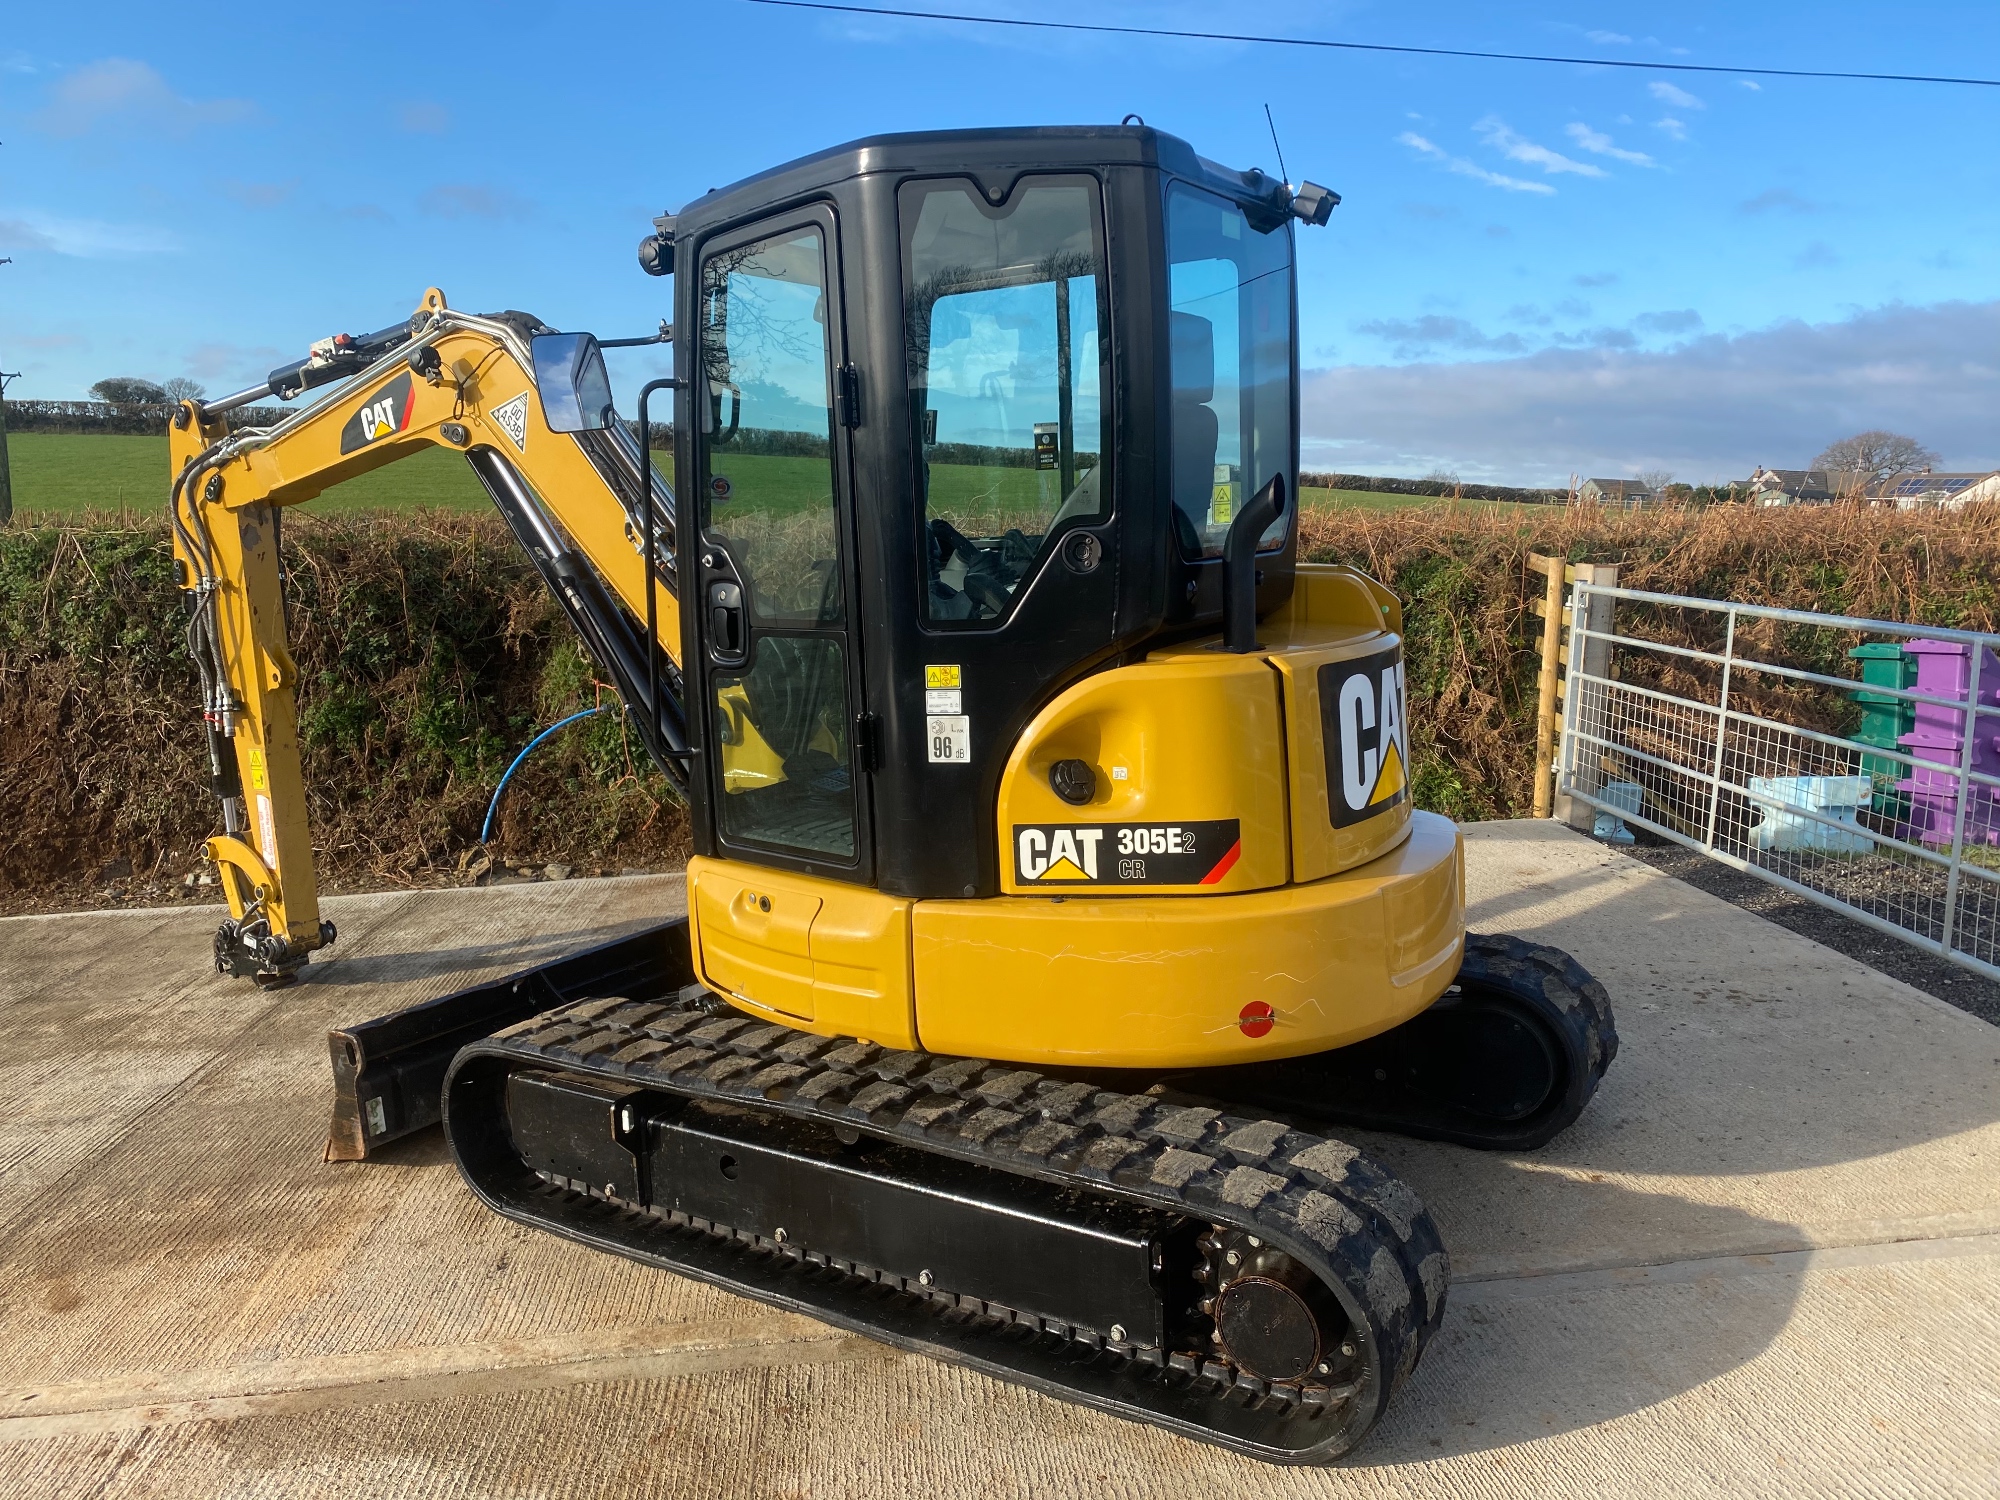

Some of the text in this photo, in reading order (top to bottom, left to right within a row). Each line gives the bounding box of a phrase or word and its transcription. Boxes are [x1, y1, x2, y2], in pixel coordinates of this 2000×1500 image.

[360, 397, 396, 441] CAT
[933, 736, 952, 758] 96
[955, 748, 965, 758] dB
[1019, 828, 1103, 880] CAT
[1118, 859, 1146, 879] CR
